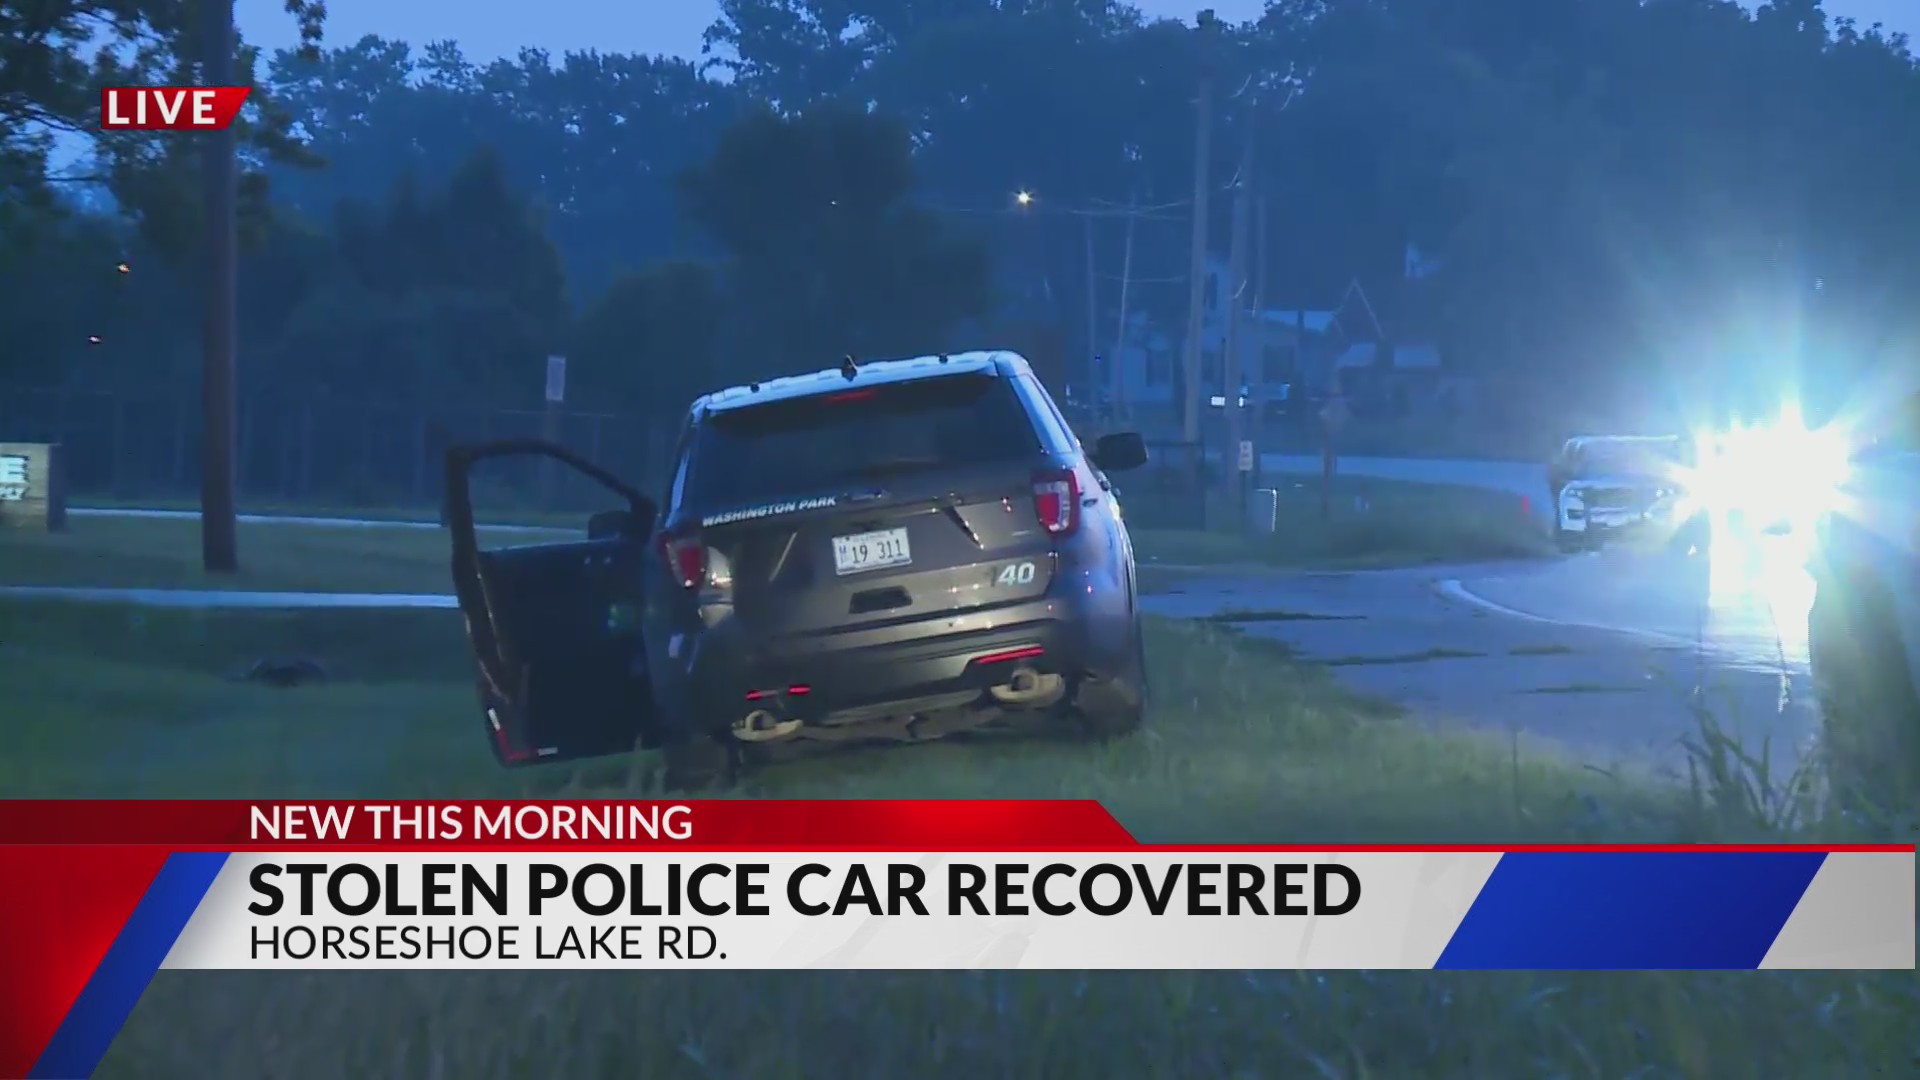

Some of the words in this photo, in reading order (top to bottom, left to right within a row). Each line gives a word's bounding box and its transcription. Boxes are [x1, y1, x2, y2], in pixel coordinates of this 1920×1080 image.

[702, 502, 796, 528] WASHINGTON
[799, 496, 837, 511] PARK
[852, 544, 868, 564] 19
[877, 538, 904, 560] 311
[998, 561, 1036, 586] 40
